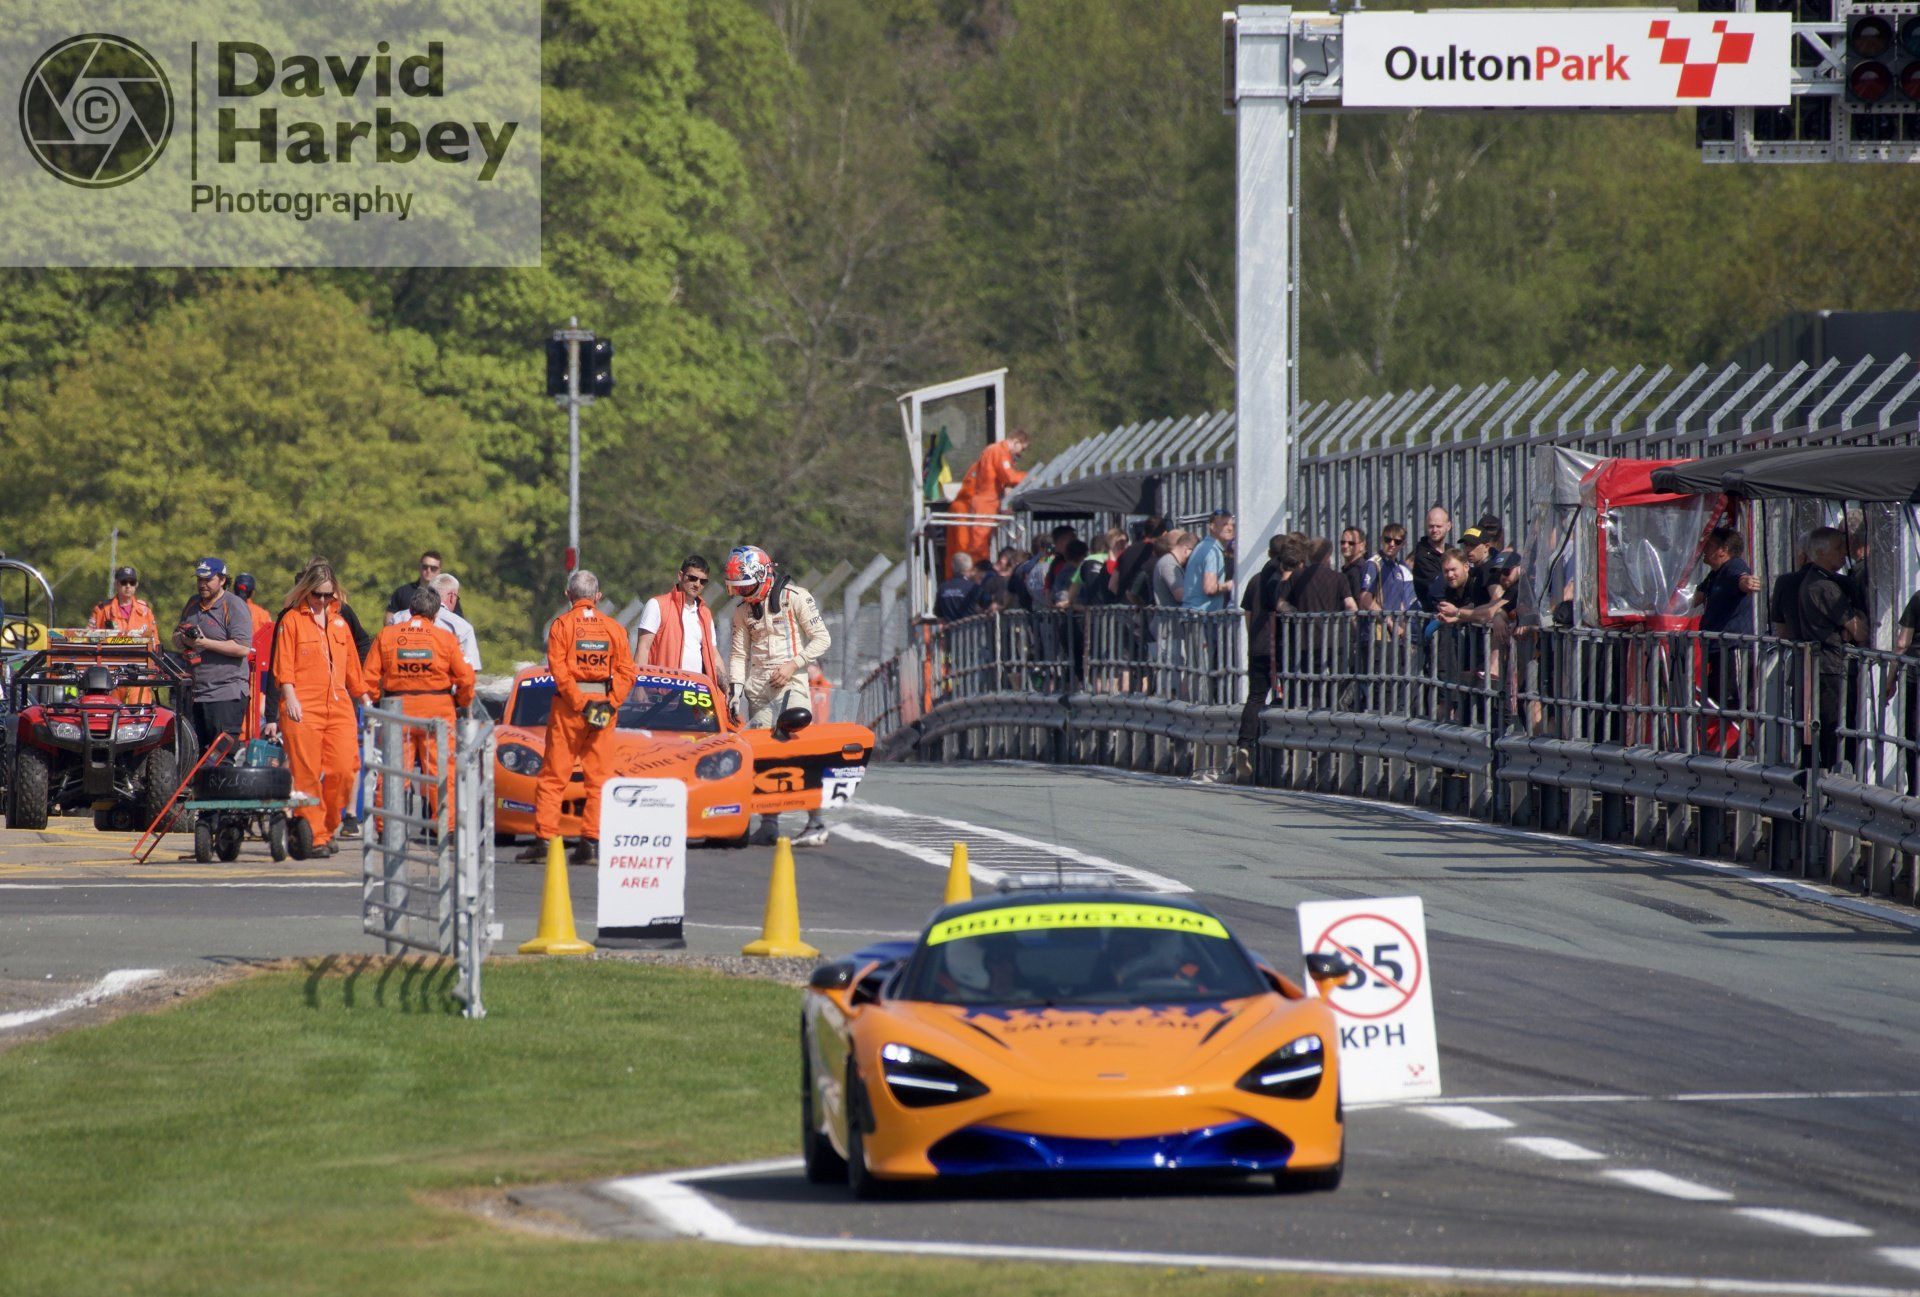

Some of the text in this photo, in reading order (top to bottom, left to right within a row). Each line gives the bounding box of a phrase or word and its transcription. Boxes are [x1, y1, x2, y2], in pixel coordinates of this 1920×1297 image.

[1384, 43, 1631, 82] OultonPark
[397, 662, 433, 674] NGK
[576, 654, 608, 667] NGK
[683, 690, 712, 708] 55
[613, 834, 672, 848] STOP GO
[609, 855, 674, 870] PENALTY
[620, 877, 660, 889] AREA
[945, 912, 1205, 936] BRITISHGT.COM
[1339, 1023, 1406, 1050] KPH
